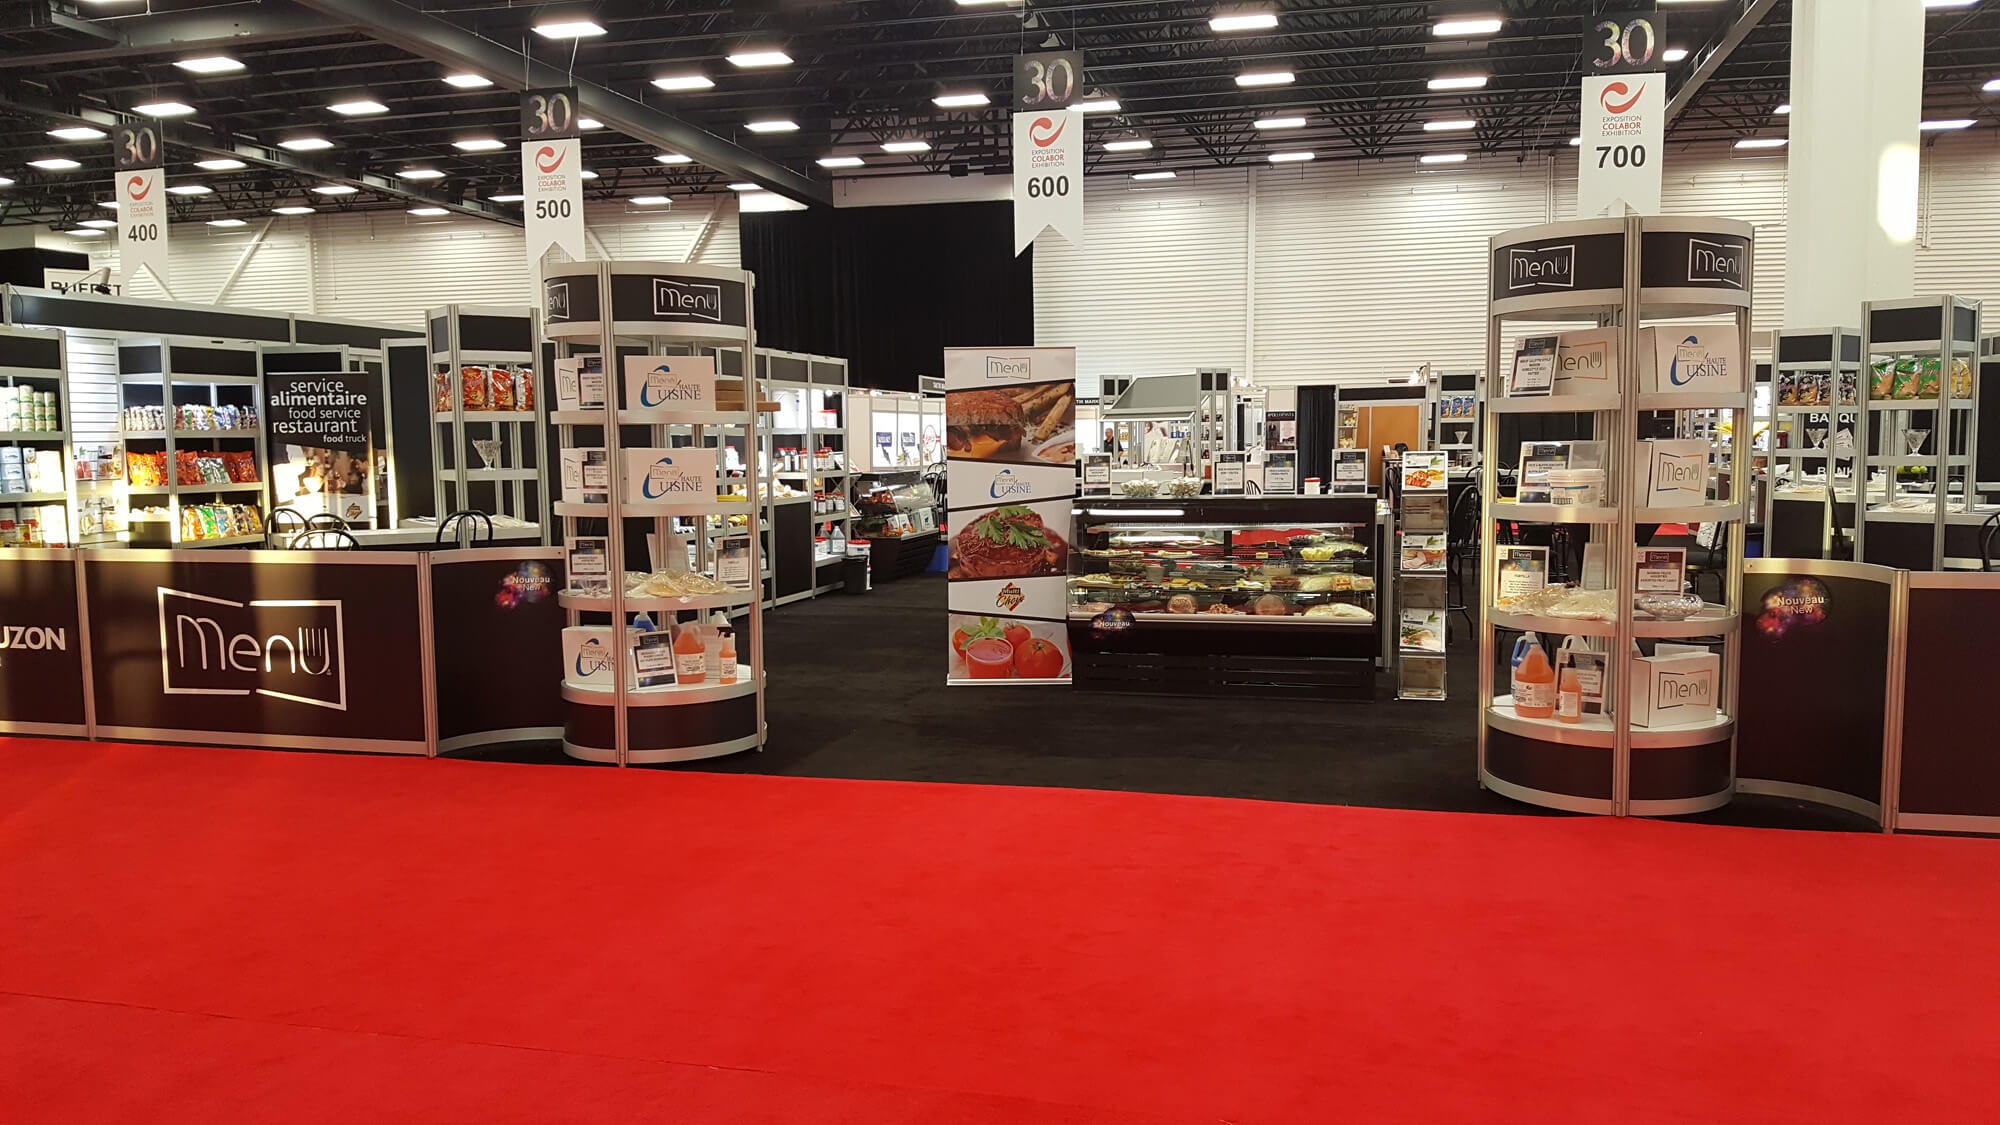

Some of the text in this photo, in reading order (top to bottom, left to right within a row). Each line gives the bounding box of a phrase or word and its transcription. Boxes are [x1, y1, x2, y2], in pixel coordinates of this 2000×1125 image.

[1592, 18, 1655, 68] 30
[1022, 57, 1074, 105] 30
[527, 93, 572, 135] 30
[1602, 122, 1642, 130] COLABOR
[119, 127, 156, 165] 30
[1031, 154, 1065, 163] COLABOR
[1595, 144, 1646, 169] 700
[1027, 175, 1069, 198] 600
[535, 199, 572, 219] 500
[128, 223, 158, 242] 400
[1556, 351, 1602, 373] enu
[1706, 357, 1727, 365] HAUTE
[290, 378, 345, 393] service
[270, 390, 367, 406] alimentaire
[289, 407, 361, 419] food service
[273, 419, 357, 434] restaurant
[323, 434, 367, 443] food truck
[512, 576, 550, 584] Nouveau
[522, 583, 541, 591] New
[1776, 595, 1825, 606] Nouveau
[1790, 606, 1813, 614] New
